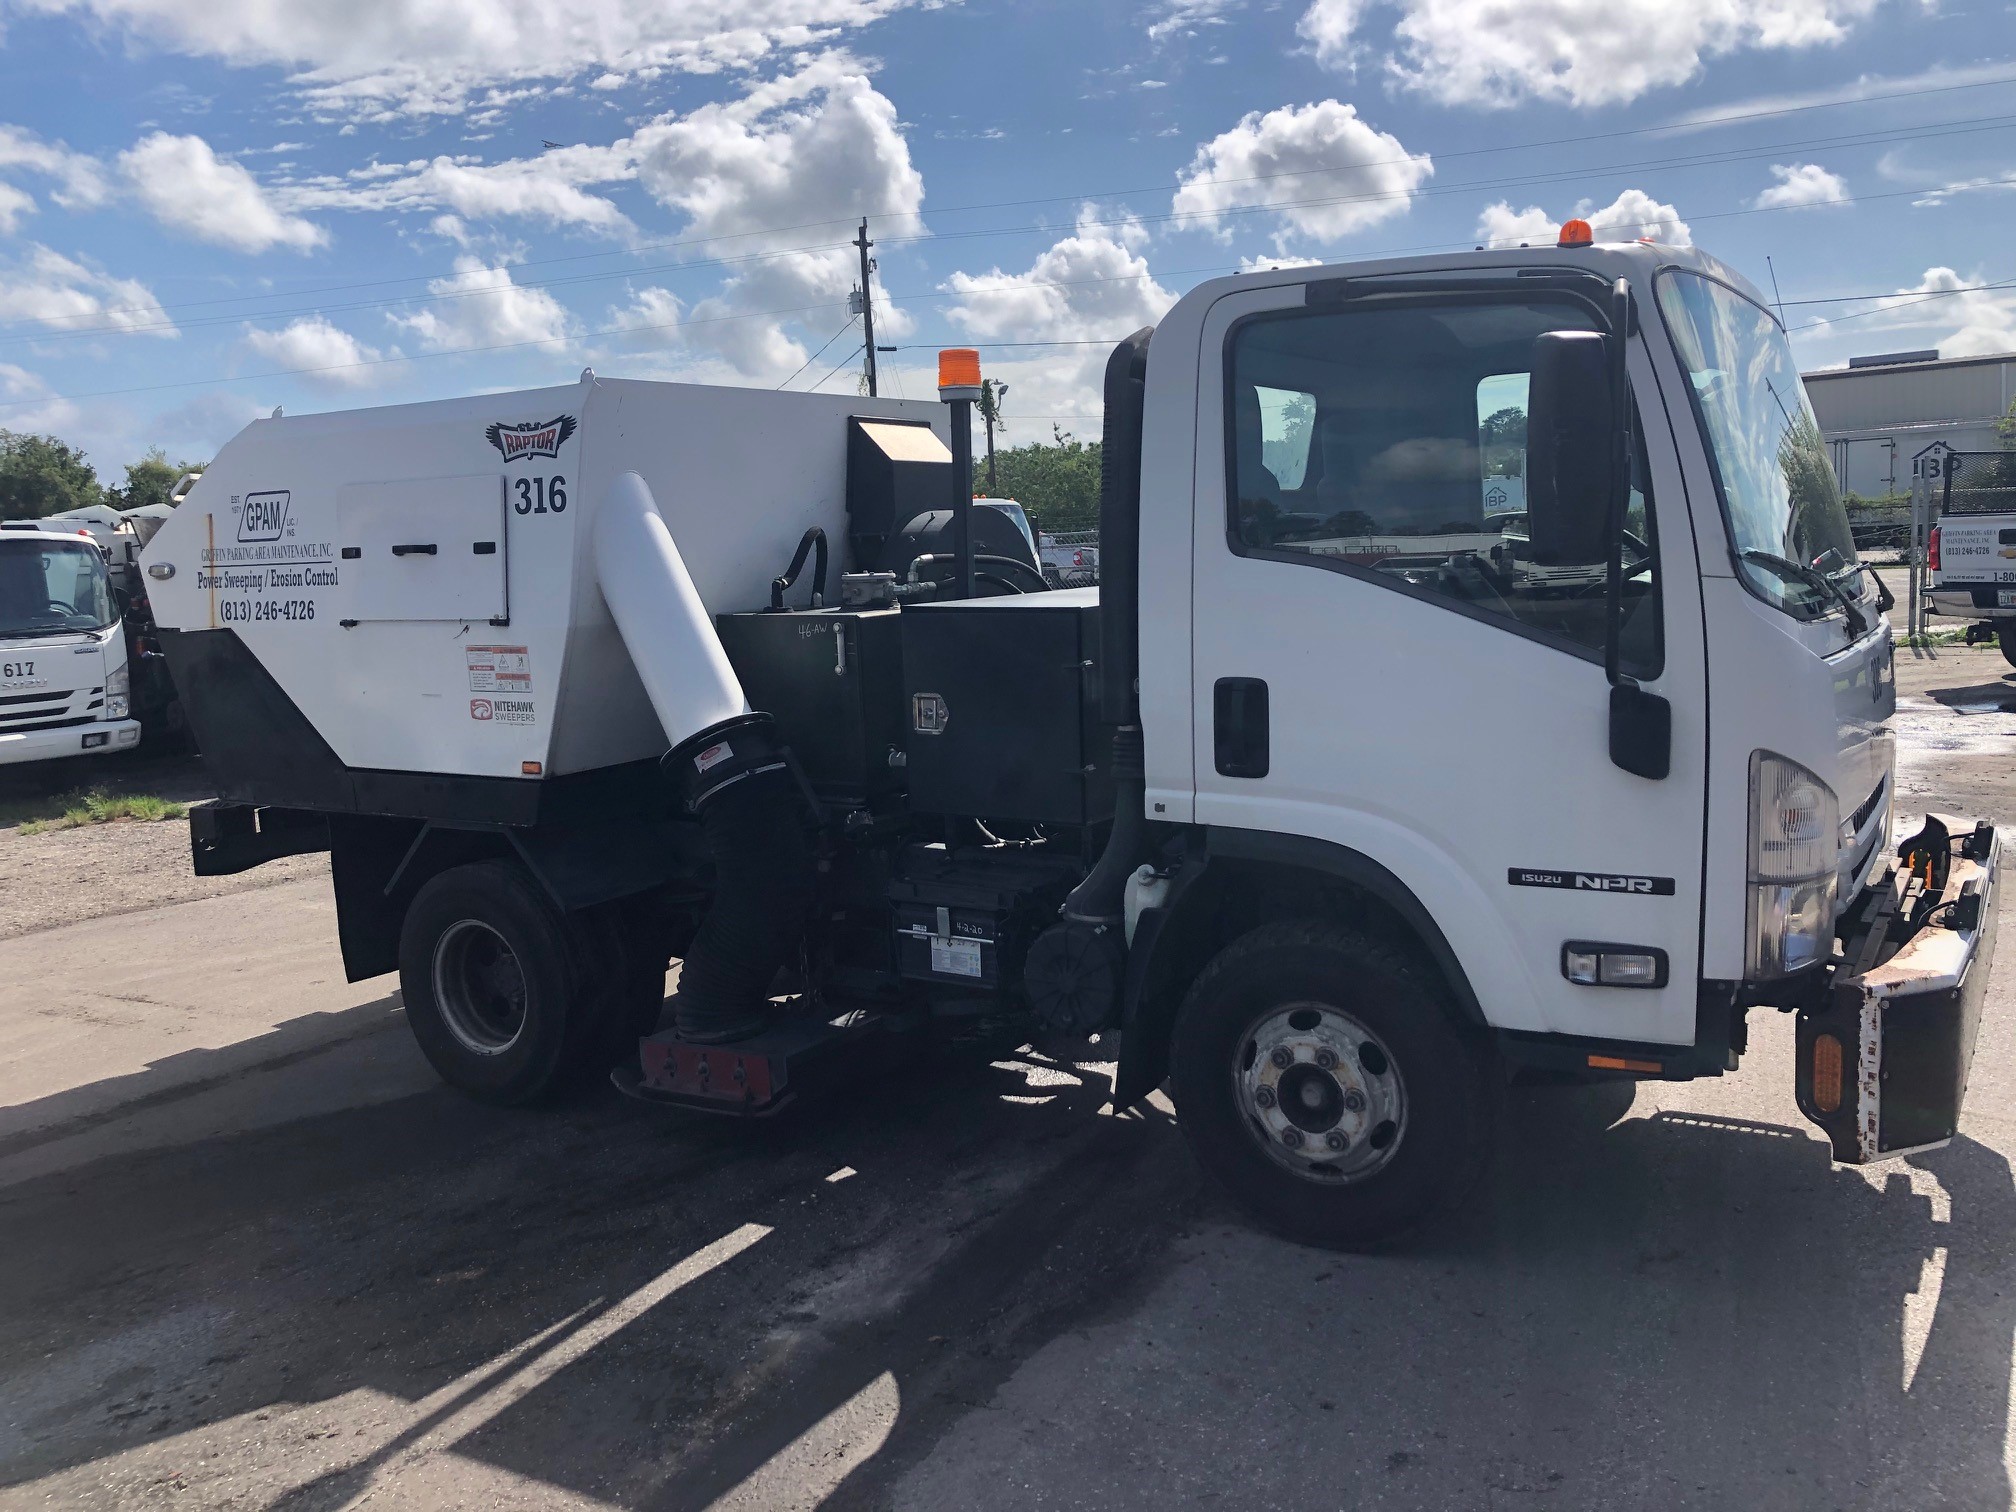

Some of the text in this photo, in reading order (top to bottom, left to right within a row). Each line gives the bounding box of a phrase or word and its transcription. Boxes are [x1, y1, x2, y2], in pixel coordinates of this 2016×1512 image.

[503, 429, 557, 455] RAPTOR
[514, 475, 567, 515] 316
[1485, 495, 1507, 507] IBP
[246, 501, 281, 531] GPAM
[201, 542, 334, 562] GRIFFIN PARKING AREA MAINTENANCE, INC.
[197, 571, 223, 589] Power
[224, 569, 263, 593] Sweeping
[270, 568, 303, 587] Erosion
[305, 566, 339, 586] Control
[1993, 572, 2016, 582] 1-80
[220, 599, 315, 623] (813) 246-4726
[3, 661, 35, 678] 617
[494, 700, 536, 713] NITEHAWK
[494, 712, 536, 722] SWEEPERS
[1521, 873, 1653, 892] ISUZU NPR
